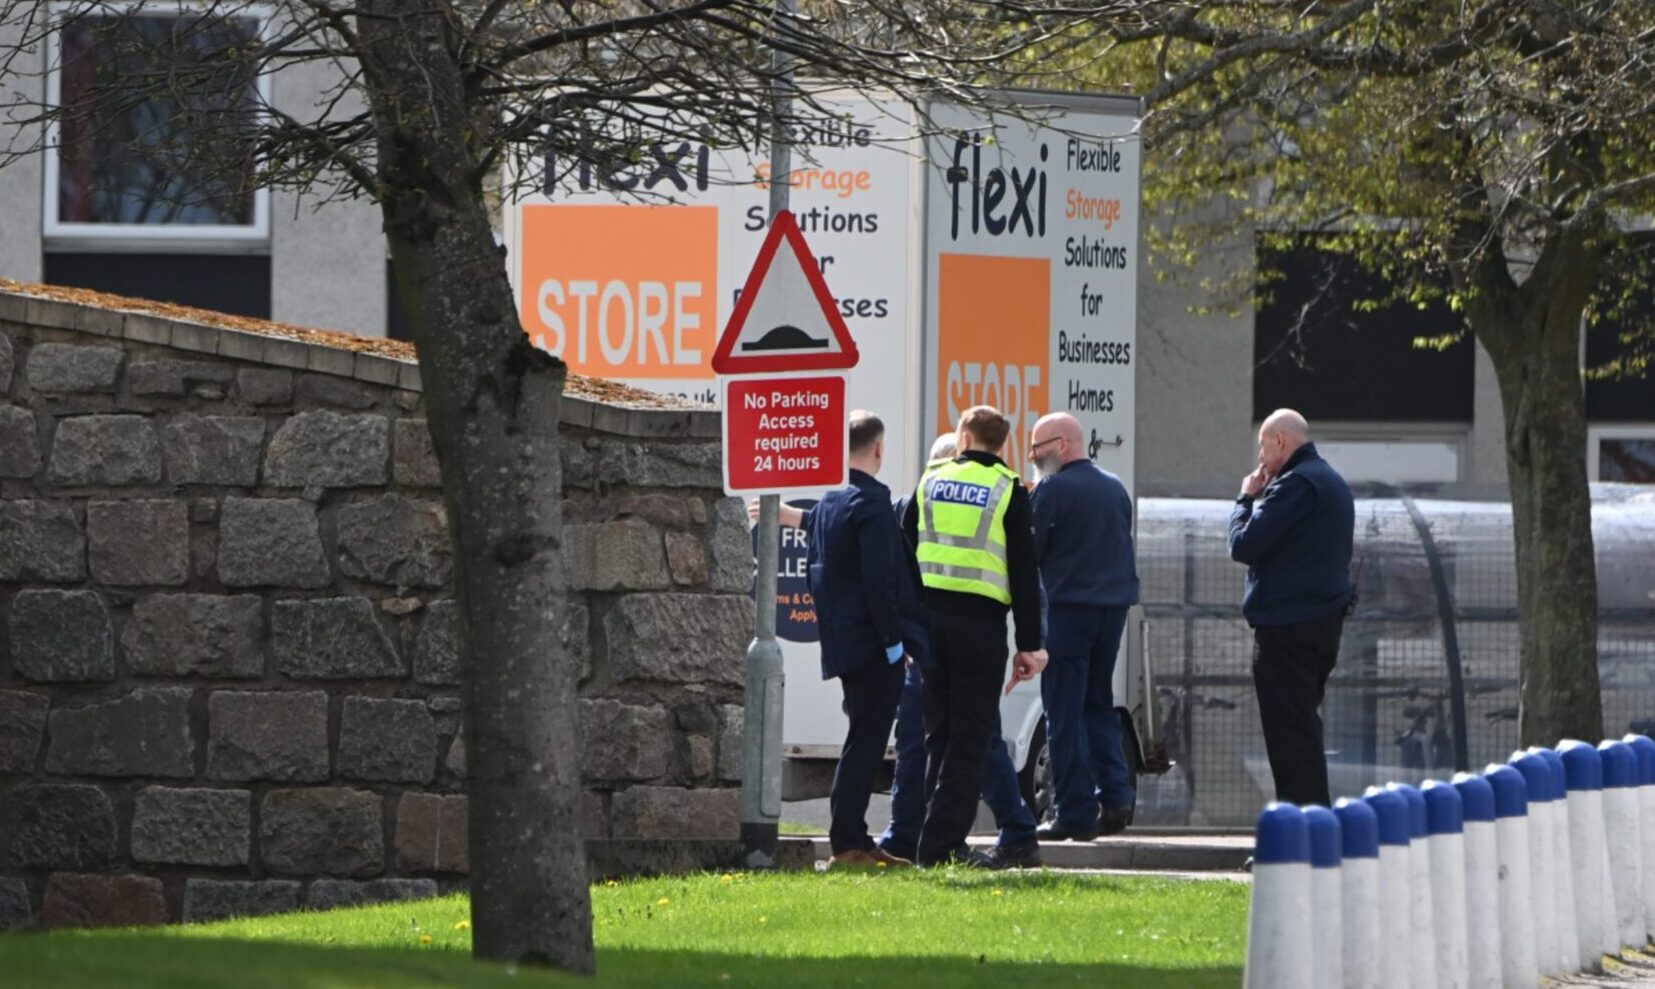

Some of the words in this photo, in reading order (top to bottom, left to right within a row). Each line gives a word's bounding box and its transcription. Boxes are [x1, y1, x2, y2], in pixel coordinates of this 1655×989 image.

[1067, 139, 1121, 172] Flexible
[752, 161, 871, 198] Sorage
[947, 131, 1048, 241] flexi
[744, 205, 879, 233] Sutions
[1066, 188, 1121, 230] Storage
[1065, 235, 1127, 269] Solutions
[1081, 283, 1103, 317] for
[536, 278, 703, 366] STORE
[1058, 330, 1130, 365] Businesses
[744, 393, 767, 409] No
[772, 391, 828, 409] Parking
[1068, 379, 1114, 413] Homes
[759, 414, 814, 430] Access
[755, 433, 818, 452] required
[754, 455, 773, 472] 24
[779, 454, 820, 471] hours
[932, 482, 989, 505] POLICE
